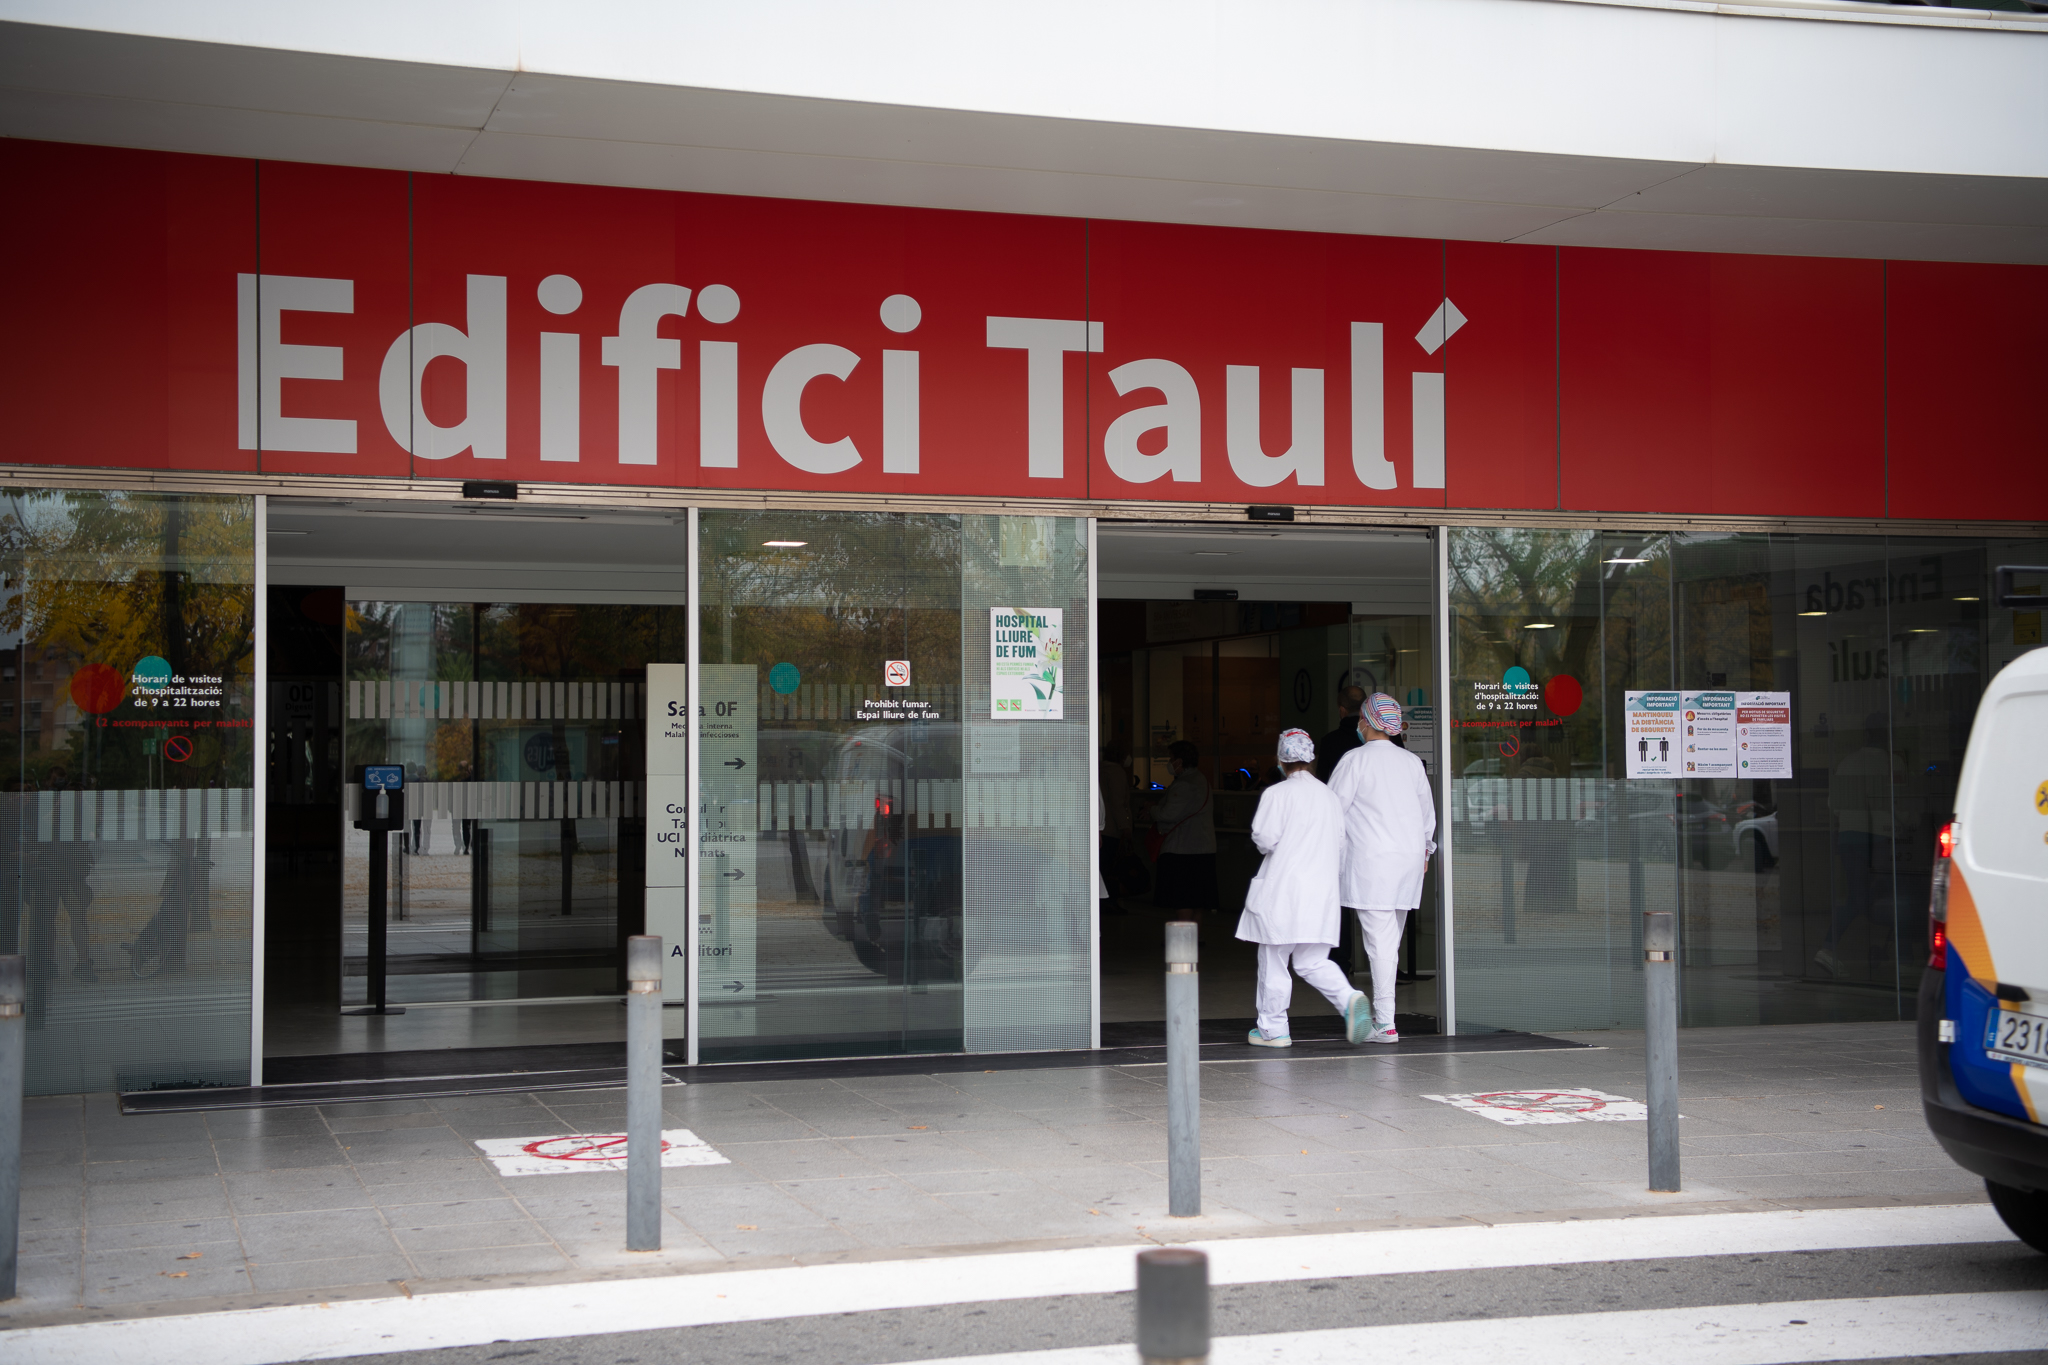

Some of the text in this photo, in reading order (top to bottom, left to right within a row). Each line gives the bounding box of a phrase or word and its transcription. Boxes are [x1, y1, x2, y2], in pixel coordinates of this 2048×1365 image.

[237, 273, 1468, 490] Edifici Taulí
[996, 615, 1048, 628] HOSPITAL
[996, 630, 1033, 642] LLIURE
[996, 646, 1036, 658] DE FUM
[132, 675, 222, 684] Horari de visites
[132, 686, 222, 697] d'hospitalització:
[1475, 692, 1539, 701] d'hospitalització:
[134, 698, 147, 706] de
[152, 698, 158, 706] 9
[174, 698, 187, 706] 22
[191, 698, 220, 706] hores
[668, 701, 706, 716] Saa
[856, 711, 880, 720] Espai
[96, 717, 108, 728] (2
[112, 719, 189, 729] acompanyants
[194, 720, 212, 729] per
[1450, 719, 1459, 728] (2
[1462, 720, 1516, 729] acompanyants
[1520, 720, 1532, 728] per
[657, 832, 746, 843] UCI diàtrica
[674, 848, 726, 858] Nnats
[671, 944, 732, 957] Aitori
